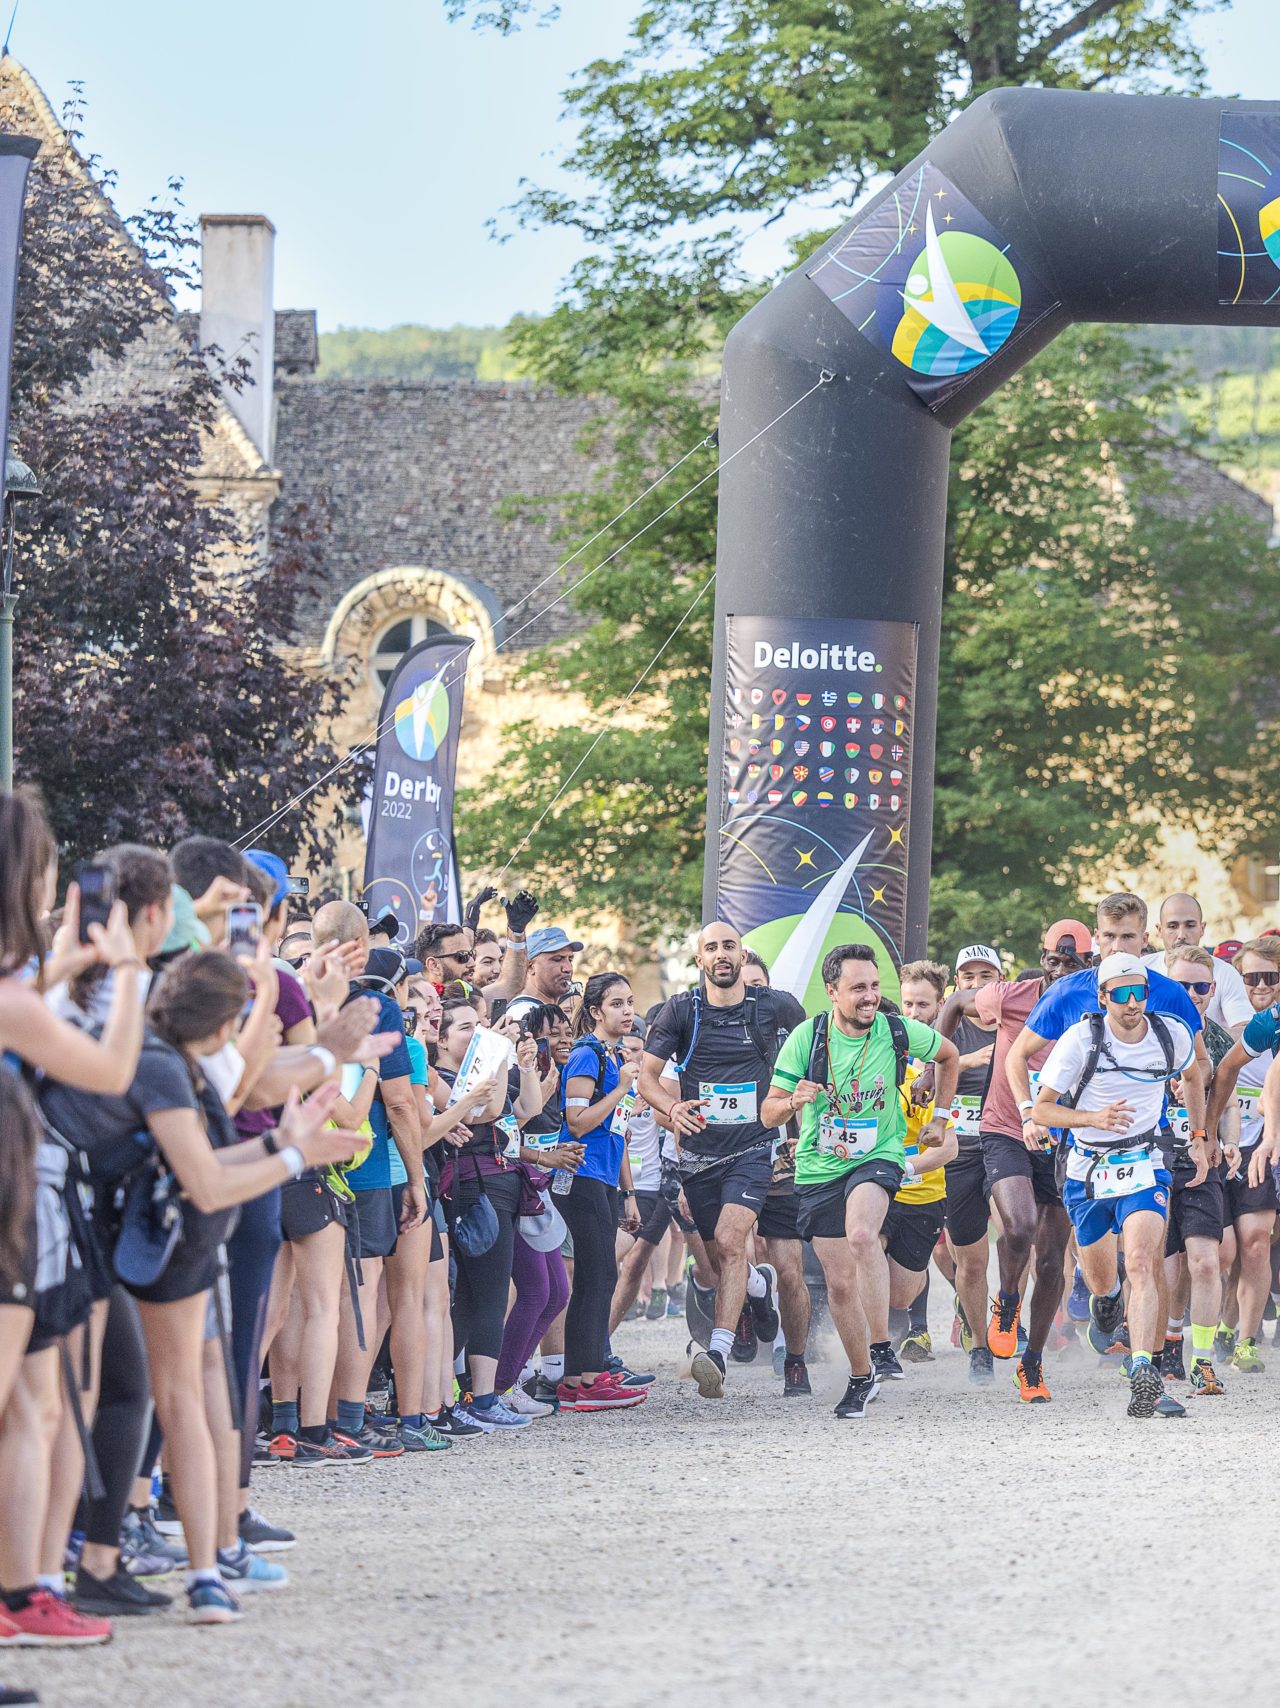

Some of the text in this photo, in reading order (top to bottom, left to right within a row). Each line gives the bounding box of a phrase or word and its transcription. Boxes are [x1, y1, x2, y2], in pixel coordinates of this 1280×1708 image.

[754, 641, 883, 673] Deloitte.
[384, 771, 441, 812] Derby
[381, 800, 412, 820] 2022
[719, 1097, 738, 1110] 78
[966, 1109, 982, 1121] 22
[838, 1132, 858, 1144] 45
[1116, 1166, 1134, 1181] 64
